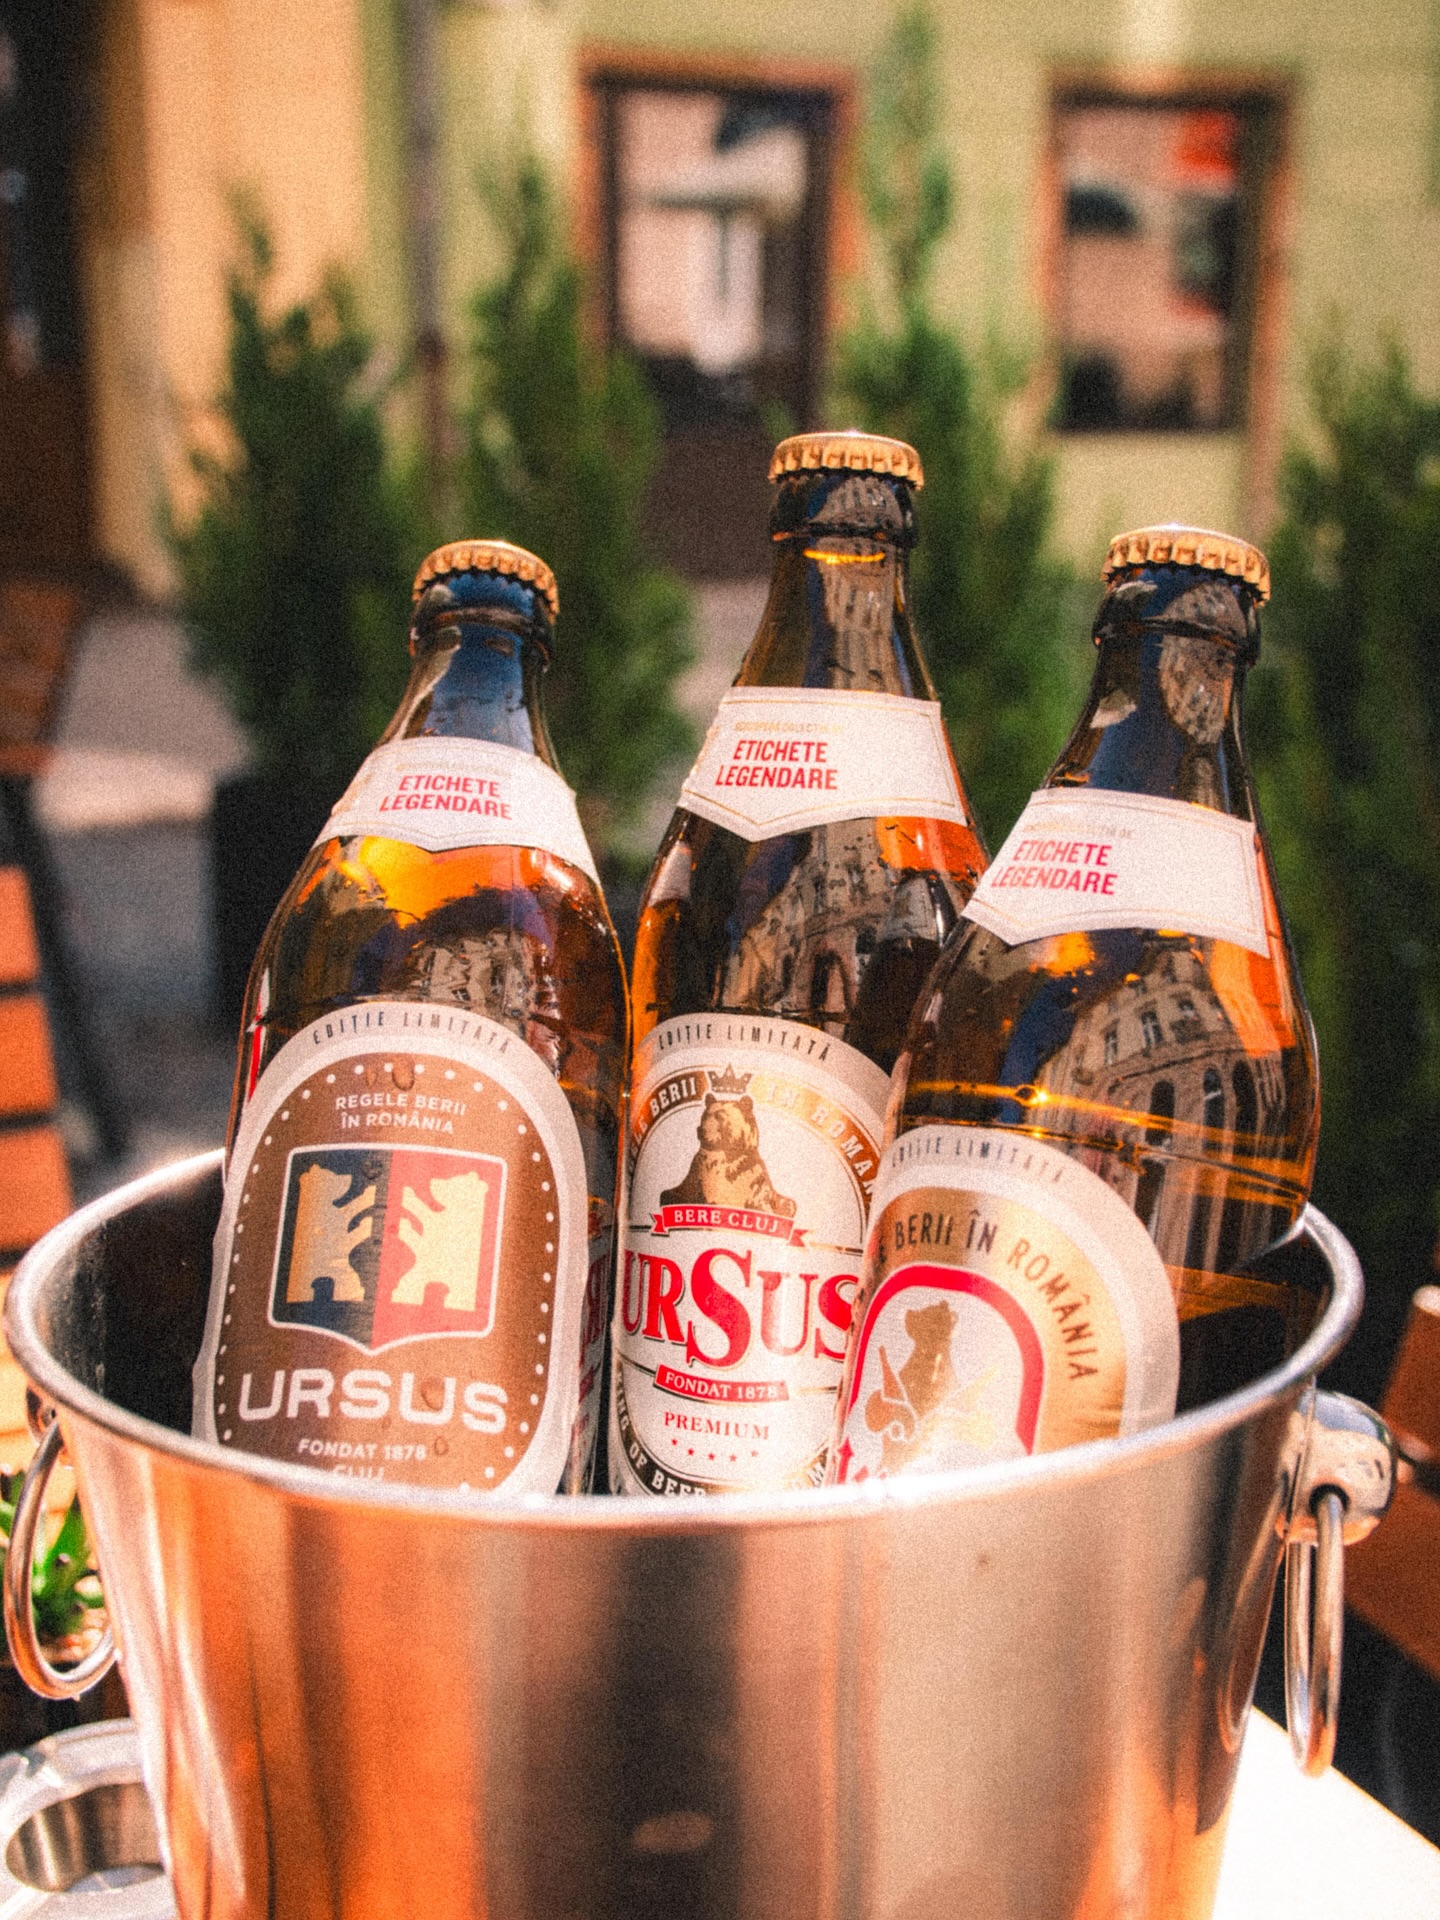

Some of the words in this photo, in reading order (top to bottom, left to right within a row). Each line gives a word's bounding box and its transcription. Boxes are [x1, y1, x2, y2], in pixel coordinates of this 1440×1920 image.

[732, 739, 828, 763] ETICHETE
[399, 774, 501, 798] ETICHETE
[714, 765, 838, 790] LEGENDARE
[379, 794, 512, 820] LEGENDARE
[1013, 840, 1112, 866] ETICHETE
[991, 865, 1118, 895] LEGENDARE
[335, 1092, 409, 1111] REGELE
[413, 1094, 467, 1117] BERII
[649, 1077, 697, 1117] BERII
[341, 1111, 361, 1129] ÎN
[365, 1110, 454, 1134] ROMÂNIA
[673, 1208, 723, 1224] BERE
[728, 1213, 780, 1234] CLUJ
[894, 1212, 954, 1250] BERII
[965, 1208, 998, 1253] ÎN
[1006, 1237, 1099, 1380] ROMÂNIA
[622, 1247, 860, 1369] URSUS
[665, 1371, 731, 1398] FONDAT
[736, 1381, 781, 1399] 1878
[238, 1368, 508, 1434] URSUS
[664, 1411, 770, 1440] PREMIUM
[297, 1438, 377, 1459] FONDAT
[382, 1444, 427, 1461] 1878
